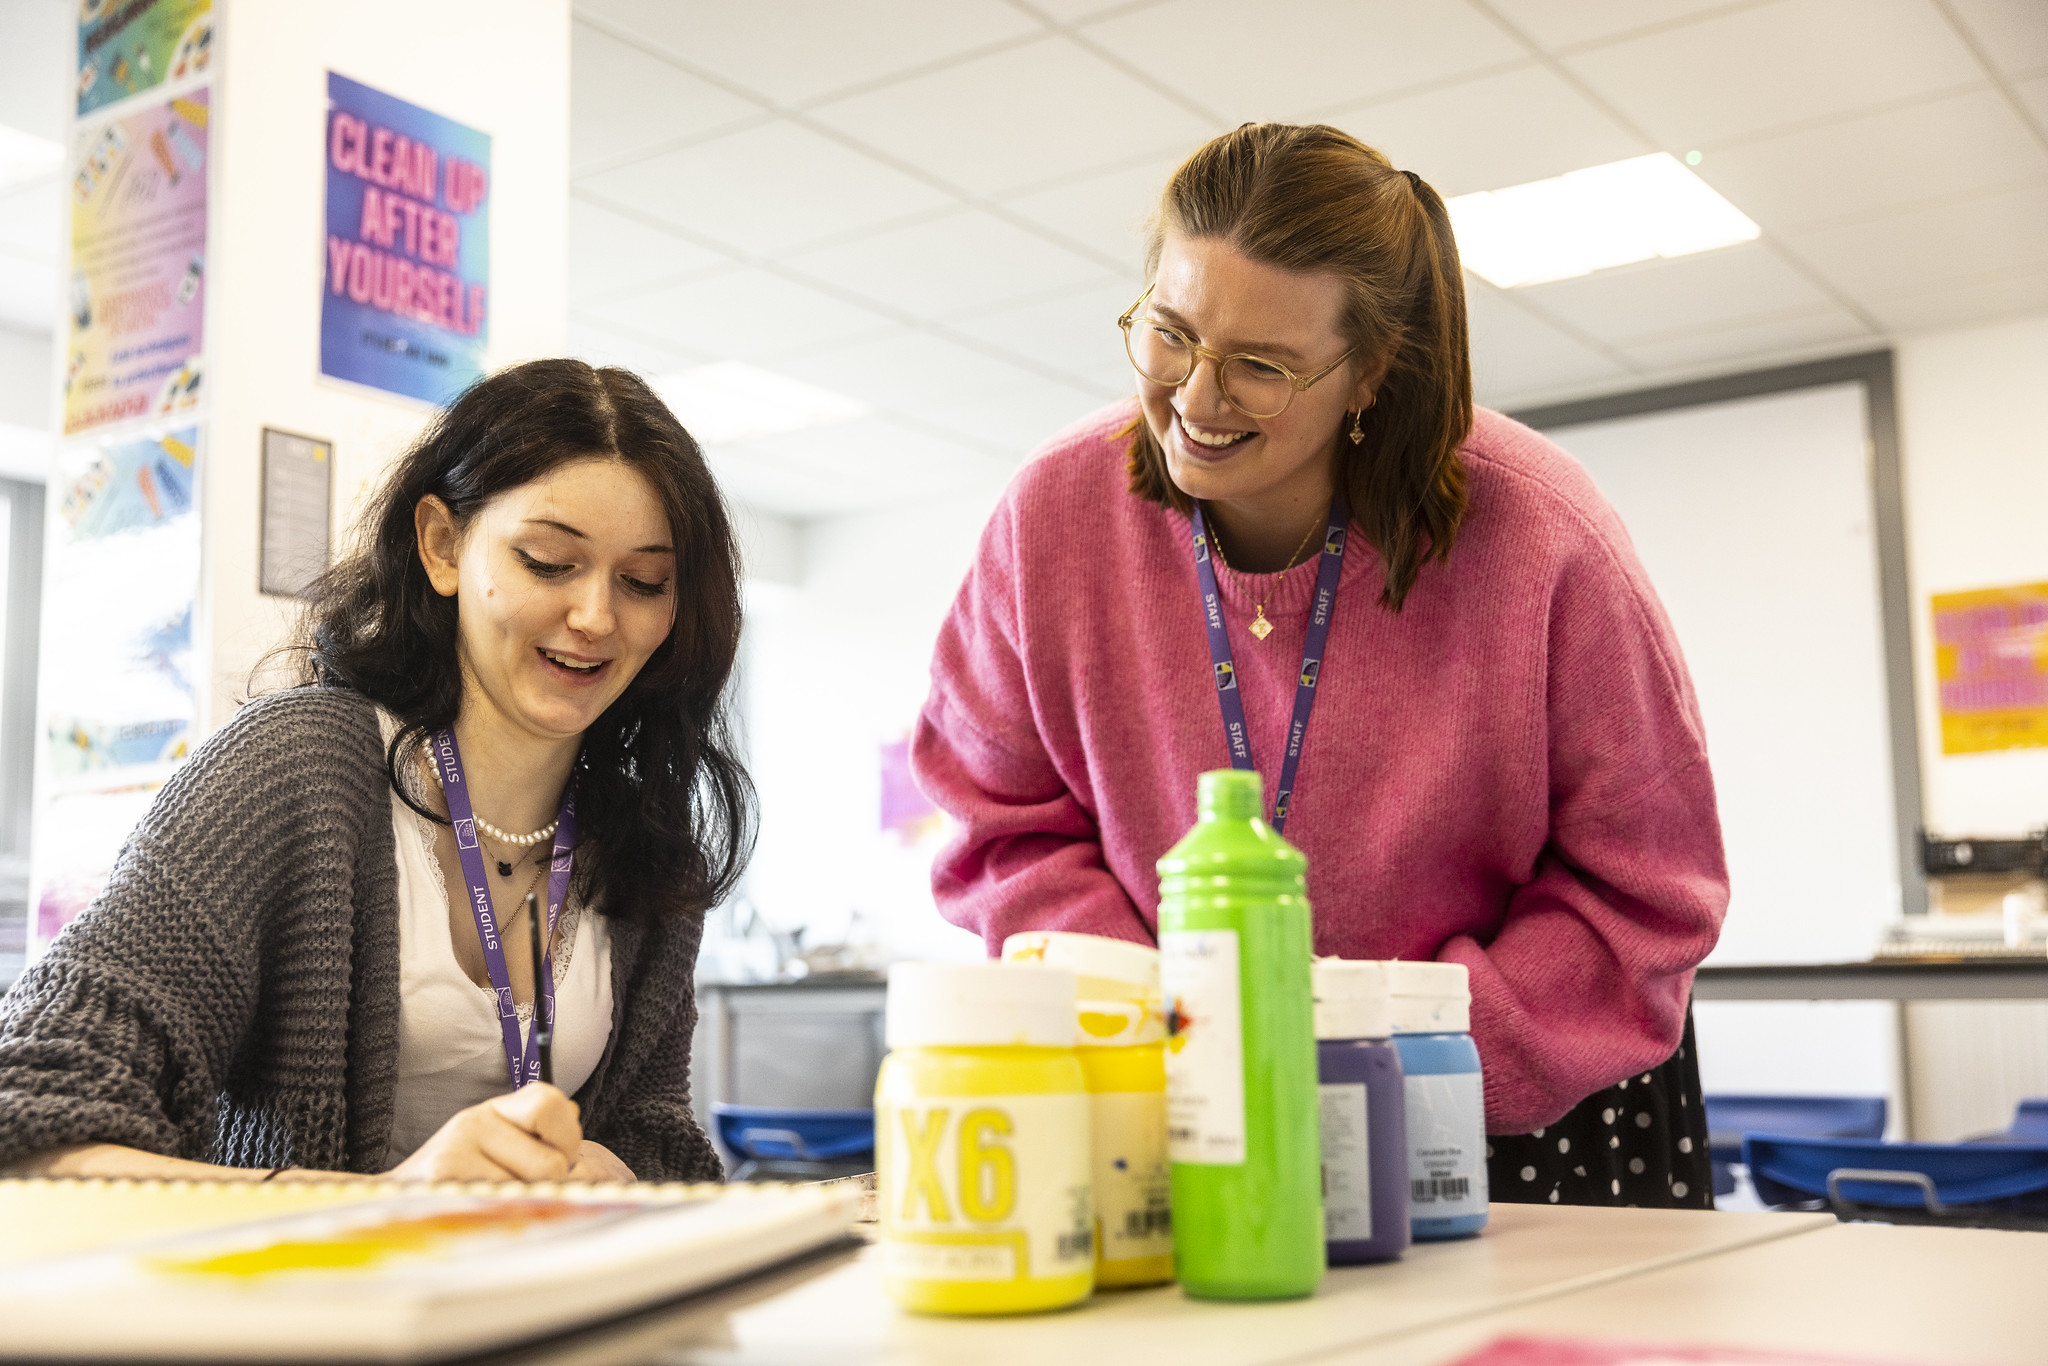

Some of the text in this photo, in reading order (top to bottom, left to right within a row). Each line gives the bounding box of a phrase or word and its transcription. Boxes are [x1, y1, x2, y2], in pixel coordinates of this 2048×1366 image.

[331, 113, 487, 215] CLEAN UP
[360, 184, 460, 270] AFTER
[328, 233, 486, 337] YOURSELF
[1205, 593, 1221, 629] STAFF
[1314, 588, 1331, 625] STAFF
[438, 729, 460, 783] STUDEN
[1229, 722, 1247, 758] STAFF
[1289, 720, 1304, 757] STAFF
[473, 885, 499, 950] STUDENT
[899, 1107, 1017, 1224] X6
